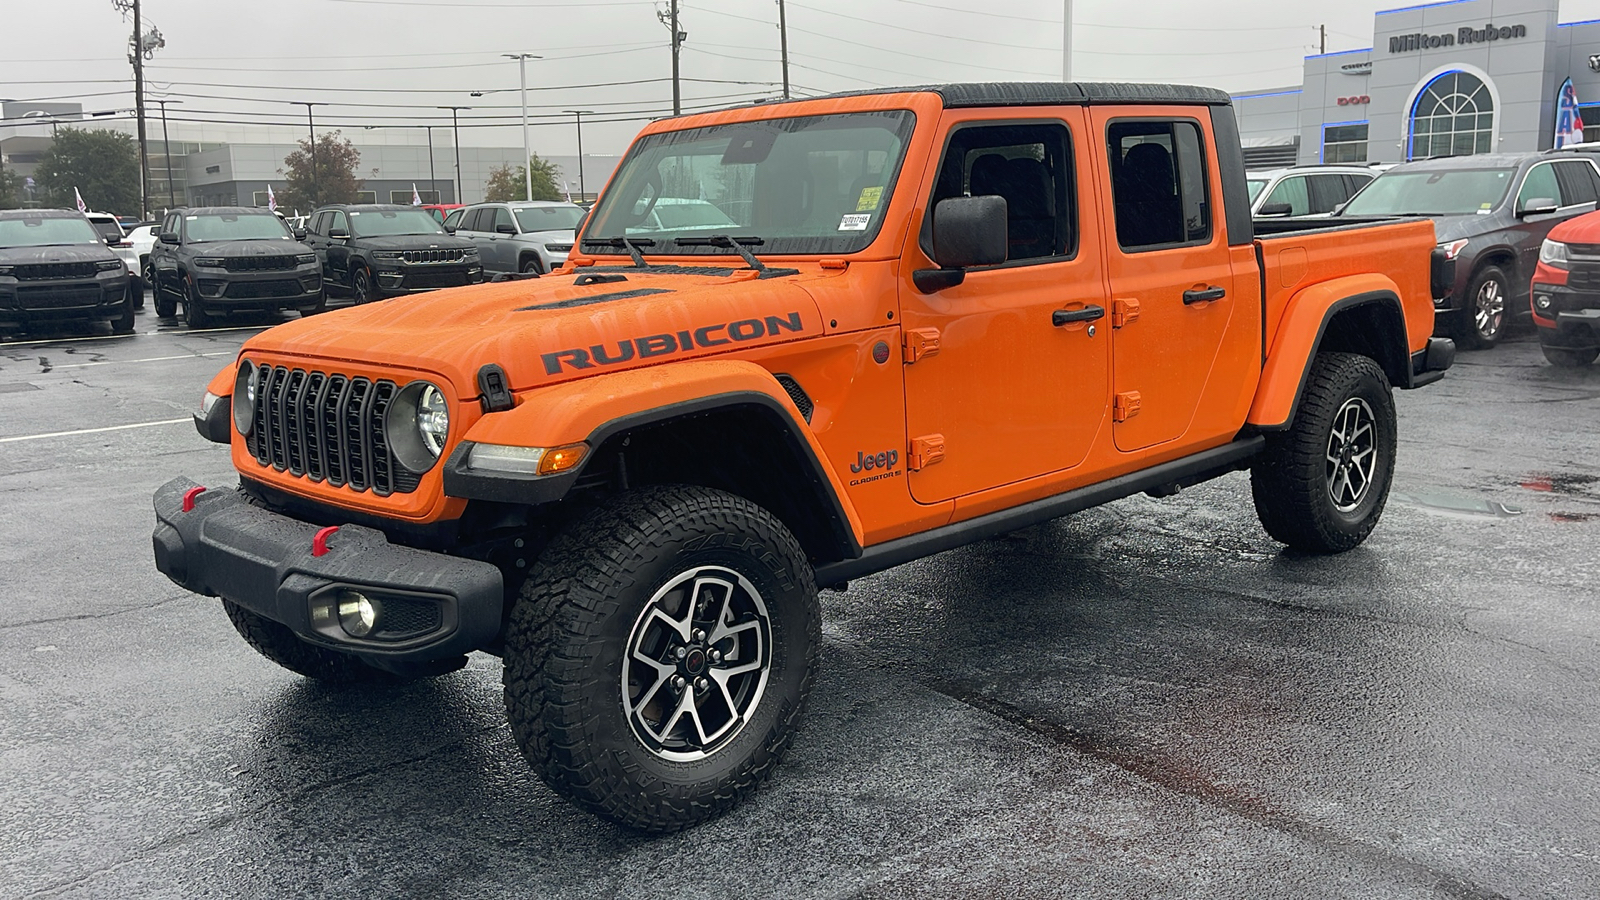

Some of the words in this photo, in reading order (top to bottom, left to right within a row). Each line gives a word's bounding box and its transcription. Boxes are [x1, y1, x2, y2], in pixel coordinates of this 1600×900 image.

[1389, 33, 1454, 53] Milton
[1457, 24, 1526, 44] Ruben
[540, 312, 803, 376] RUBICON
[850, 450, 898, 473] Jeep
[850, 472, 894, 486] GLADIATOR
